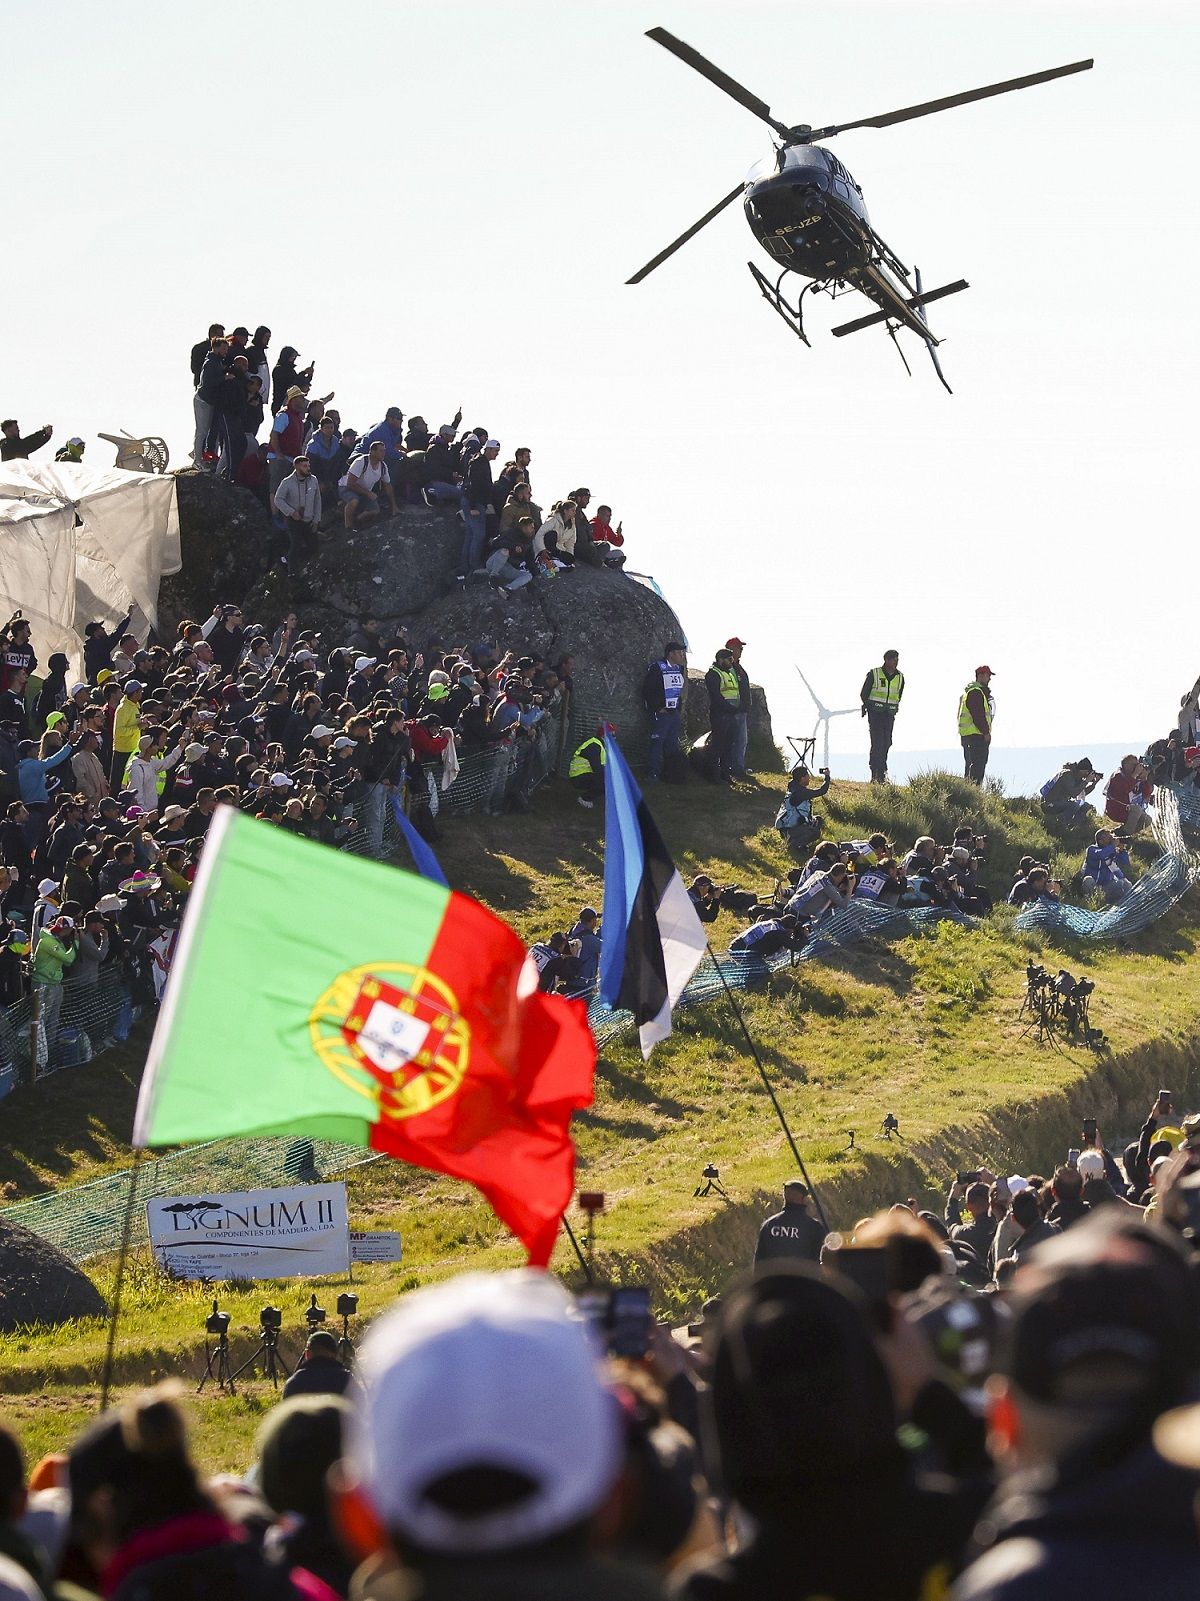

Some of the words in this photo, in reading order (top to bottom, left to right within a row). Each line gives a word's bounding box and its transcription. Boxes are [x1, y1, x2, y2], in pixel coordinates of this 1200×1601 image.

[861, 876, 877, 886] 234
[317, 1199, 334, 1224] II
[205, 1229, 264, 1239] COMPONENTES
[265, 1229, 276, 1237] DE
[277, 1225, 317, 1236] MADEIRA,
[318, 1223, 335, 1232] LDA
[350, 1232, 367, 1241] MP
[770, 1226, 800, 1239] GNR
